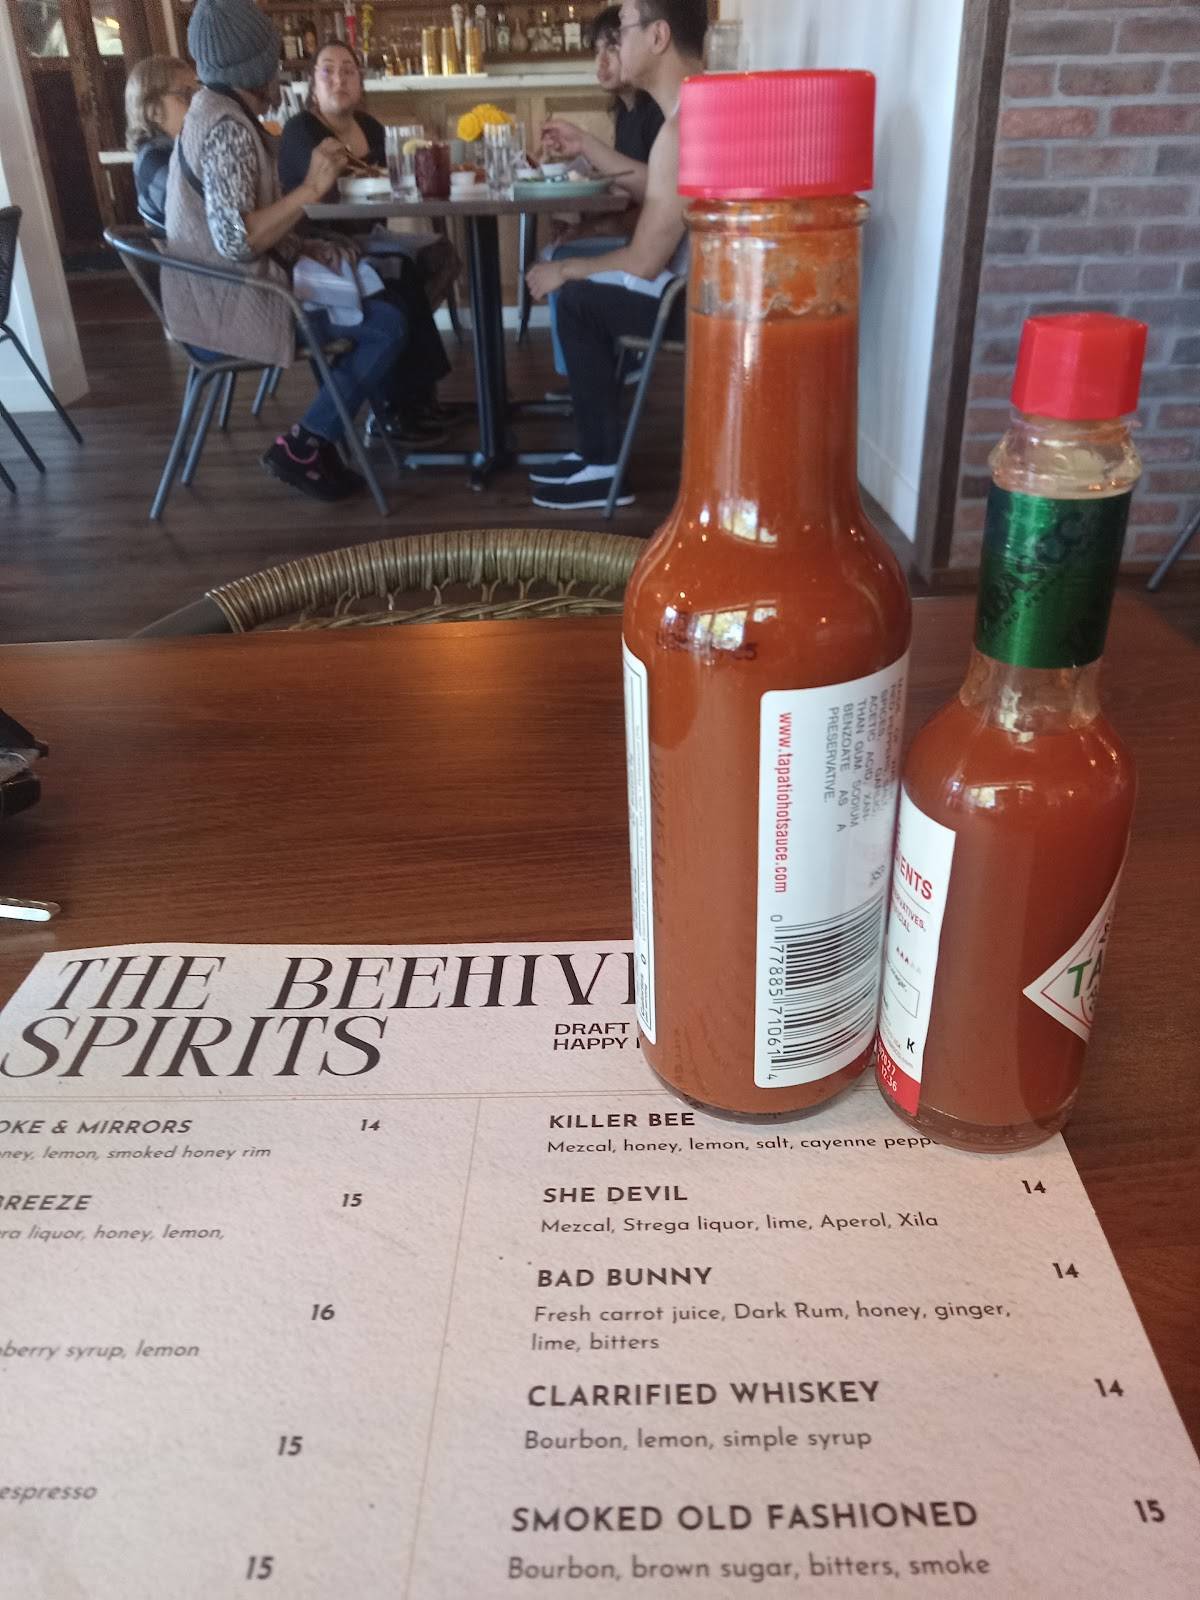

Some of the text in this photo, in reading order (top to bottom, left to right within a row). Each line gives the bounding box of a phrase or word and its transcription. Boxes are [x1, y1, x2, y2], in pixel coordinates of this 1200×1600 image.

[824, 706, 839, 803] PRESERVATIVE.
[836, 703, 854, 832] BENZOATE AS A
[774, 712, 793, 893] www.tapatiohotsauce.com
[896, 855, 933, 900] ENTS
[770, 914, 783, 923] 0
[768, 944, 785, 996] 77885
[45, 955, 225, 1010] THE
[555, 1023, 630, 1035] DRAFT
[767, 1006, 783, 1055] 71061
[0, 1016, 388, 1078] SPIRITS
[554, 1038, 628, 1050] HAPPY
[907, 1037, 916, 1054] K
[880, 1050, 896, 1076] 2027
[51, 1120, 67, 1134] &
[77, 1120, 192, 1133] MIRRORS
[361, 1119, 380, 1131] 14
[550, 1113, 695, 1128] KILLER BEE
[0, 1145, 271, 1161] ney, lemon, smoked honey rim
[548, 1139, 616, 1153] Mezcal,
[624, 1139, 681, 1153] honey,
[690, 1138, 748, 1150] lemon,
[757, 1136, 792, 1149] salt,
[801, 1139, 876, 1150] cayenne
[343, 1193, 362, 1207] 15
[543, 1180, 1046, 1203] SHE DEVIL 14
[0, 1224, 224, 1242] ra liquor, honey, lemon,
[542, 1212, 938, 1234] Mezcal, Strega liquor, lime, Aperol, Xila
[538, 1263, 1079, 1287] BAD BUNNY 14
[312, 1304, 335, 1320] 16
[535, 1300, 1010, 1324] Fresh carrot juice, Dark Rum, honey, ginger,
[0, 1340, 200, 1360] berry syrup, lemon
[532, 1332, 659, 1352] lime, bitters
[528, 1379, 1124, 1406] CLARRIFIED WHISKEY 14
[278, 1436, 302, 1456] 15
[525, 1426, 872, 1451] Bourbon, lemon, simple syrup
[0, 1487, 97, 1504] espresso
[512, 1500, 1165, 1532] SMOKED OLD FASHIONED 15
[247, 1556, 273, 1580] 15
[508, 1552, 989, 1583] Bourbon, brown sugar, bitters, smoke
